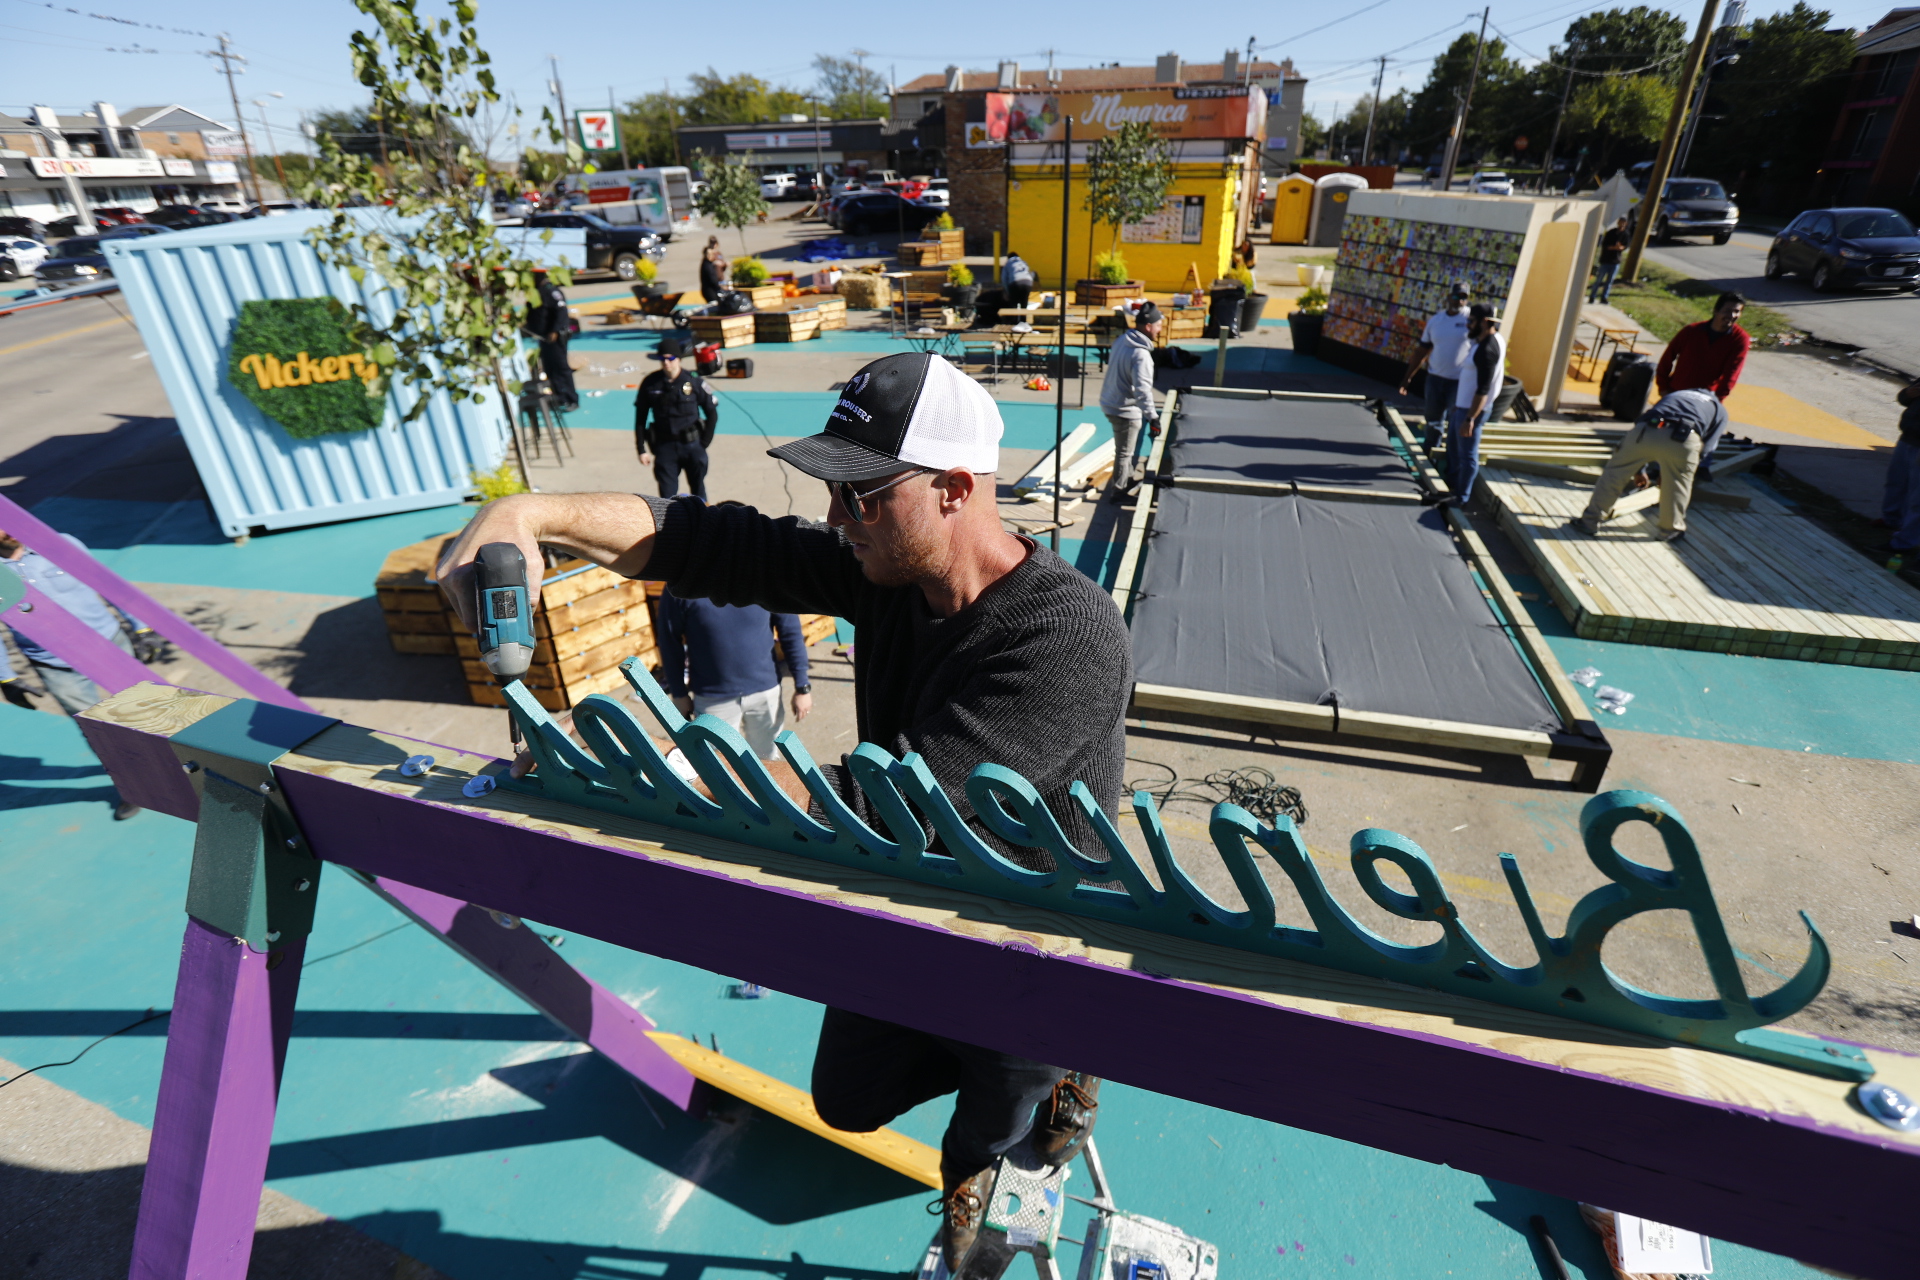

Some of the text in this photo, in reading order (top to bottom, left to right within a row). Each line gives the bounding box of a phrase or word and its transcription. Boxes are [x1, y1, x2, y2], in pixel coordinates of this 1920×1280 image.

[1080, 93, 1190, 131] Monarca
[584, 116, 607, 149] 7
[239, 350, 379, 388] Vickery
[841, 398, 873, 423] ROUSERS
